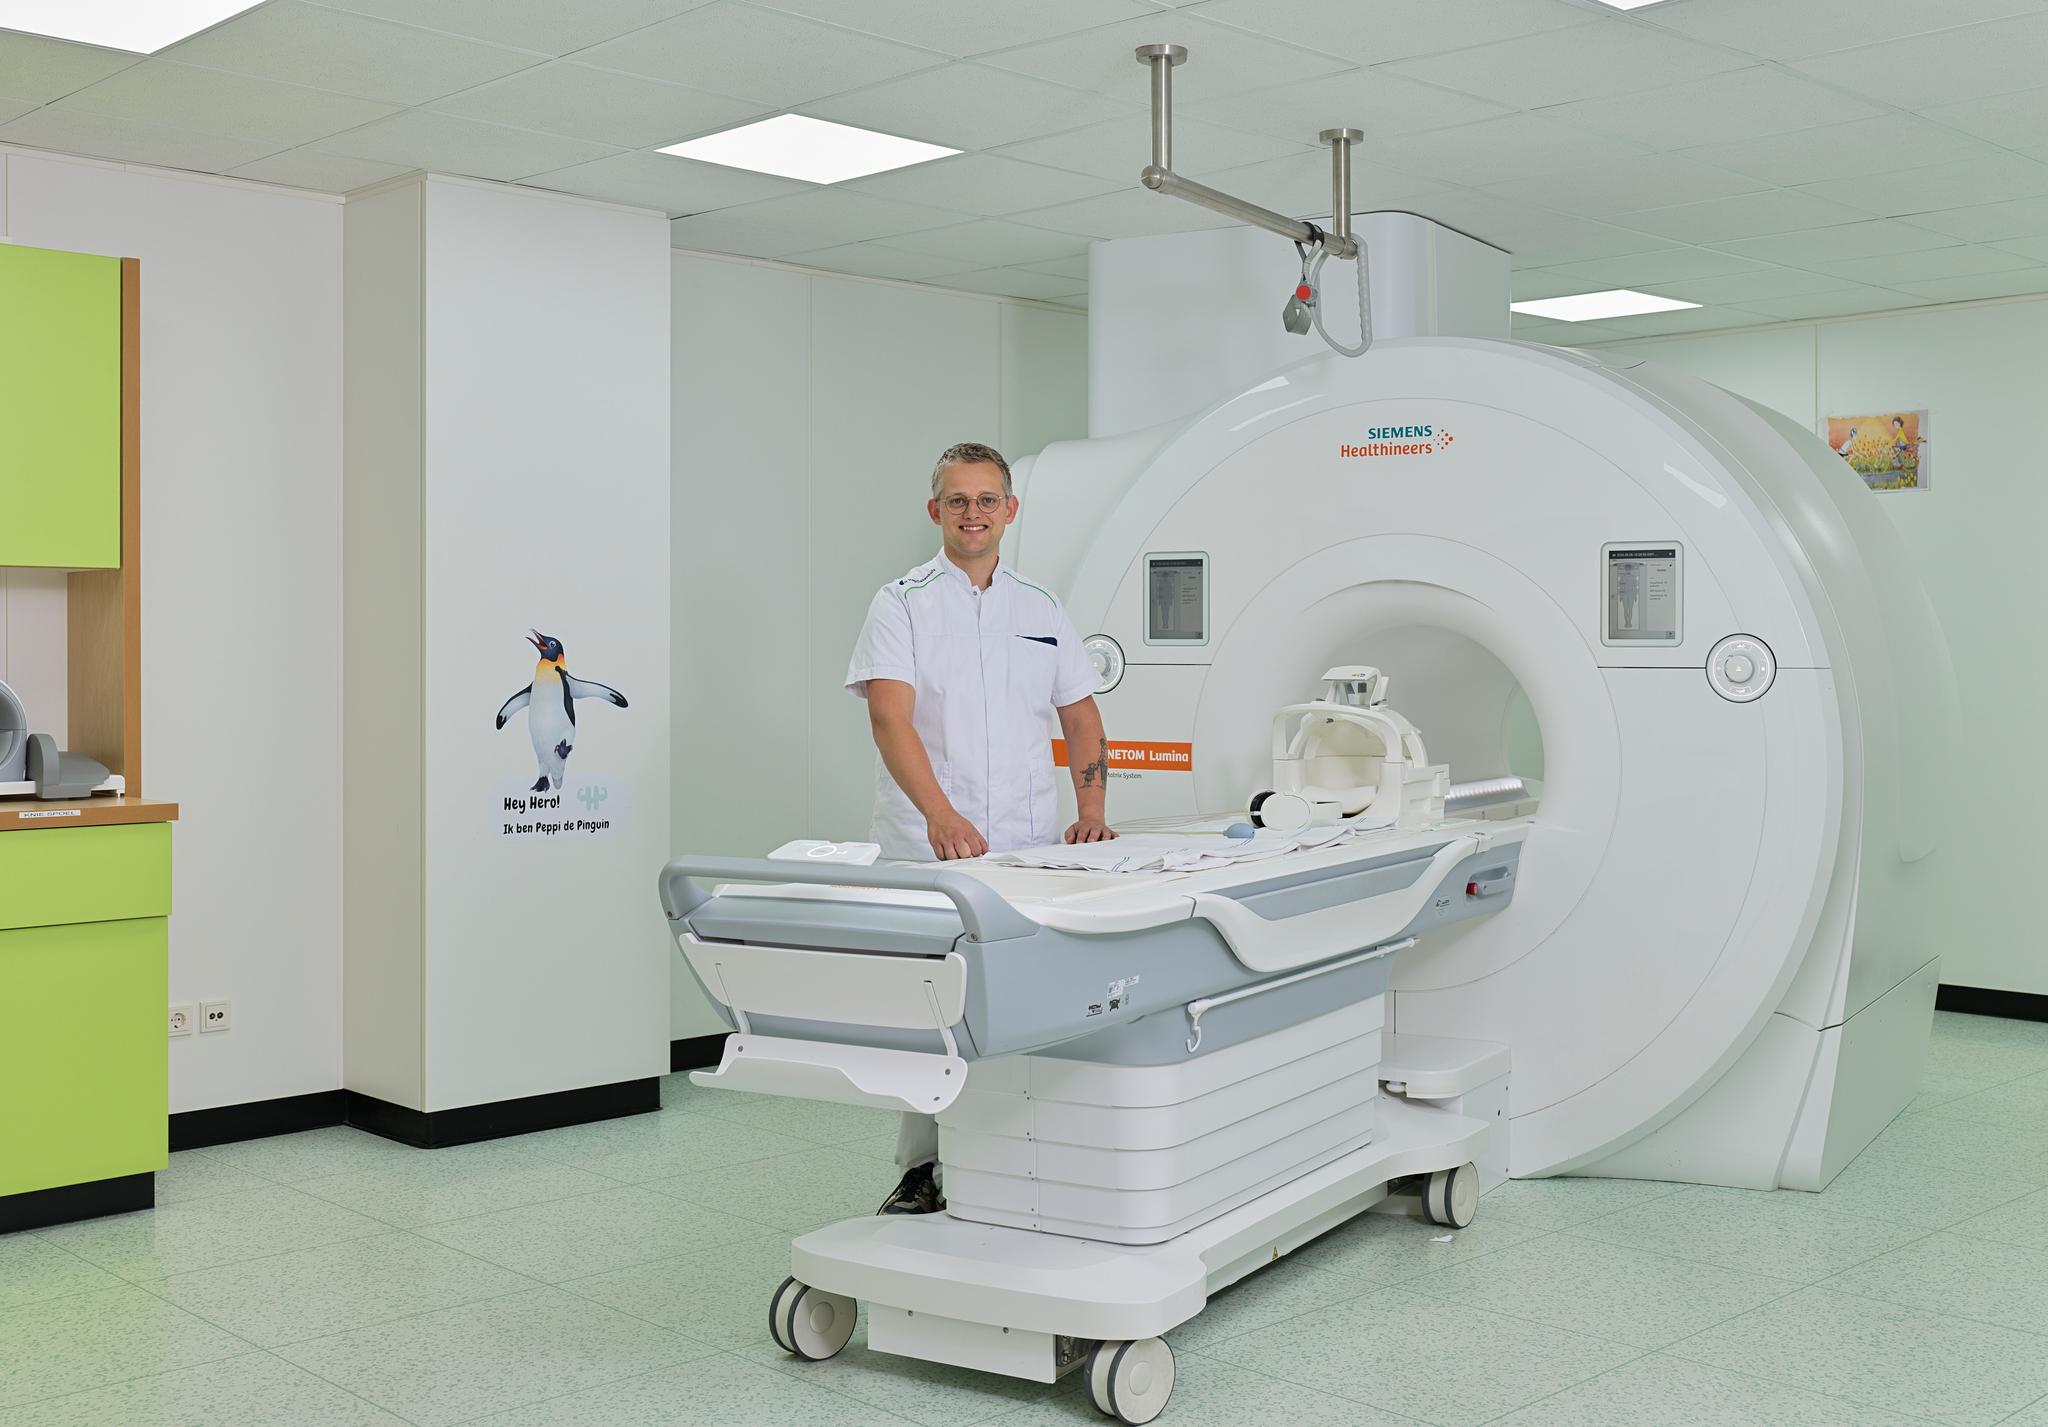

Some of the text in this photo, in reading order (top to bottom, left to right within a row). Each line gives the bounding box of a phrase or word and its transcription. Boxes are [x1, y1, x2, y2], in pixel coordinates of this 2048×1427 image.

[1368, 425, 1433, 439] SIEMENS
[1341, 442, 1433, 457] Healthineers
[1107, 749, 1189, 762] NETOM Lumina
[1123, 772, 1142, 780] System
[504, 795, 560, 814] Hey Hero!
[503, 819, 610, 836] Ik ben Peppi de Pinguin
